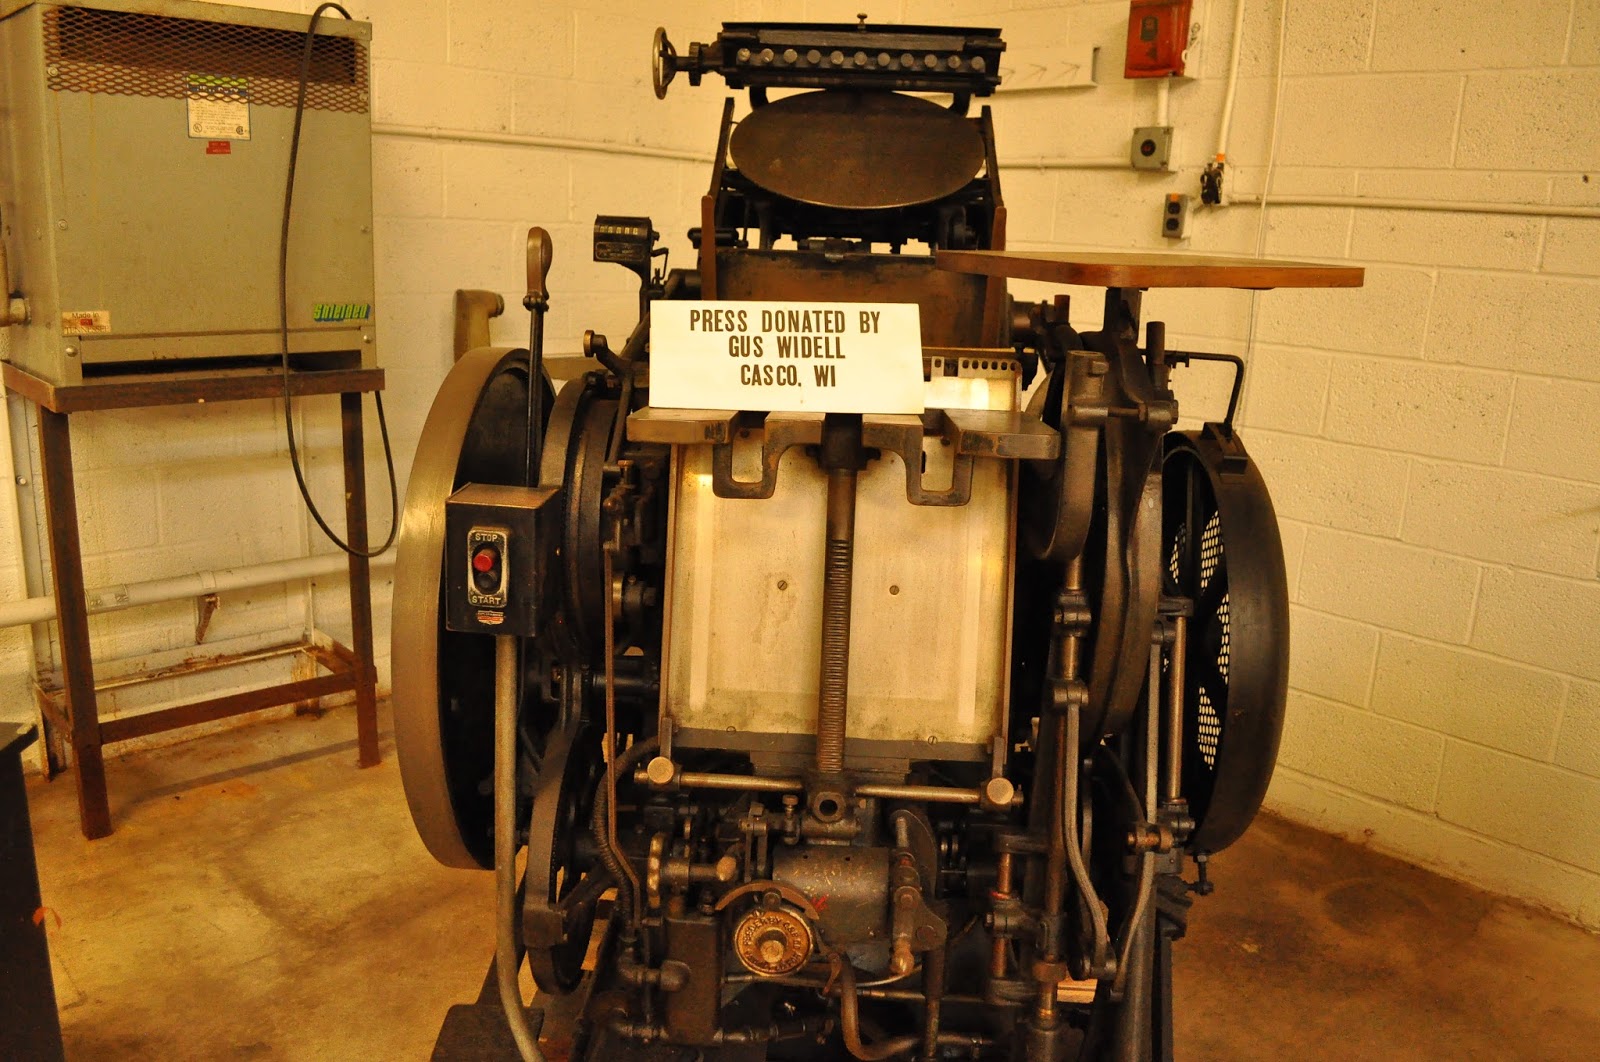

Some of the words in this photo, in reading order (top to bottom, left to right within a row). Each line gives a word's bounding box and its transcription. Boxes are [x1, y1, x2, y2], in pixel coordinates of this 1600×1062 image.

[313, 304, 371, 321] Shielded
[690, 309, 748, 332] PRESS
[762, 310, 846, 333] DONATED
[859, 311, 880, 333] BY
[729, 336, 764, 358] GUS
[777, 336, 846, 359] WIDELL
[814, 365, 836, 387] WI
[475, 533, 498, 541] STOP
[472, 596, 501, 605] START
